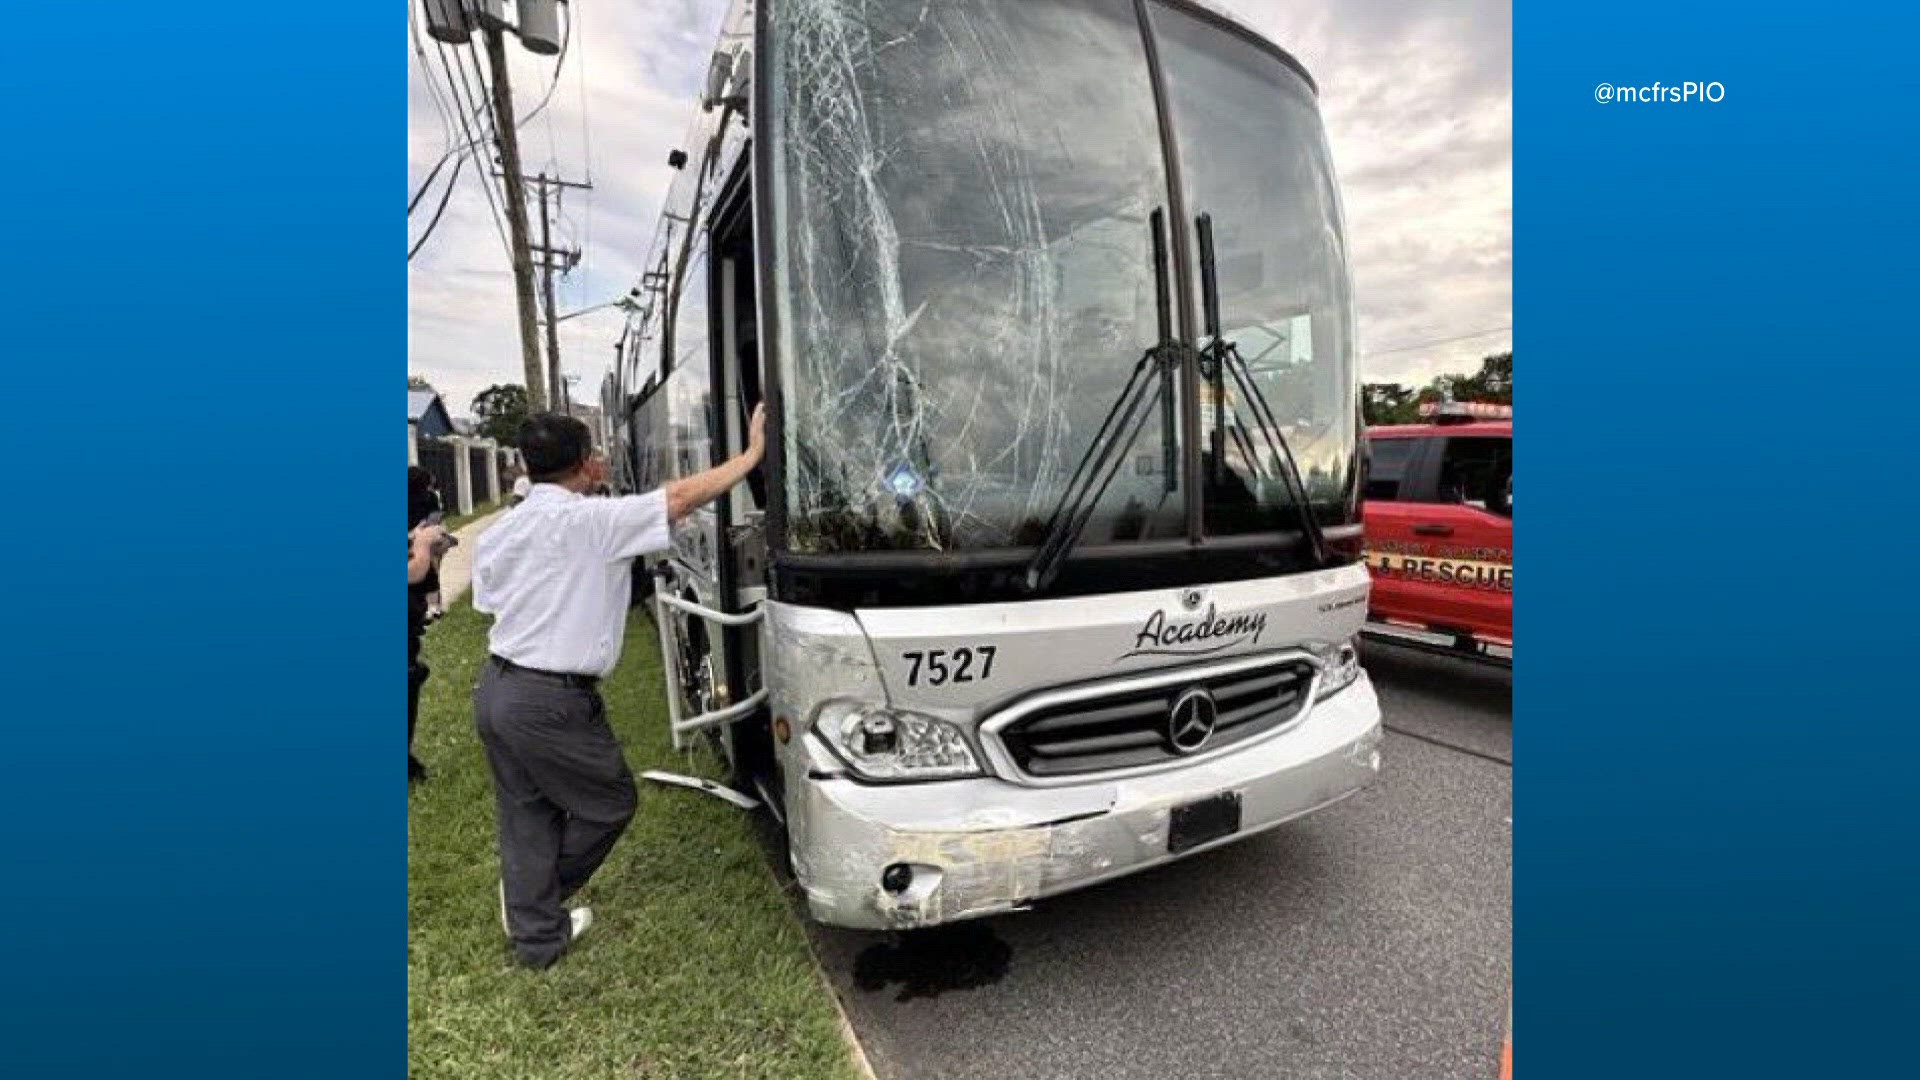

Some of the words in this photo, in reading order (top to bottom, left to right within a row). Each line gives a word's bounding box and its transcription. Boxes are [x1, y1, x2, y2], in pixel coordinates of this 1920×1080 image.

[1380, 556, 1391, 575] &
[1402, 558, 1512, 590] RESCUE
[1135, 602, 1266, 649] Academy
[903, 645, 997, 686] 7527
